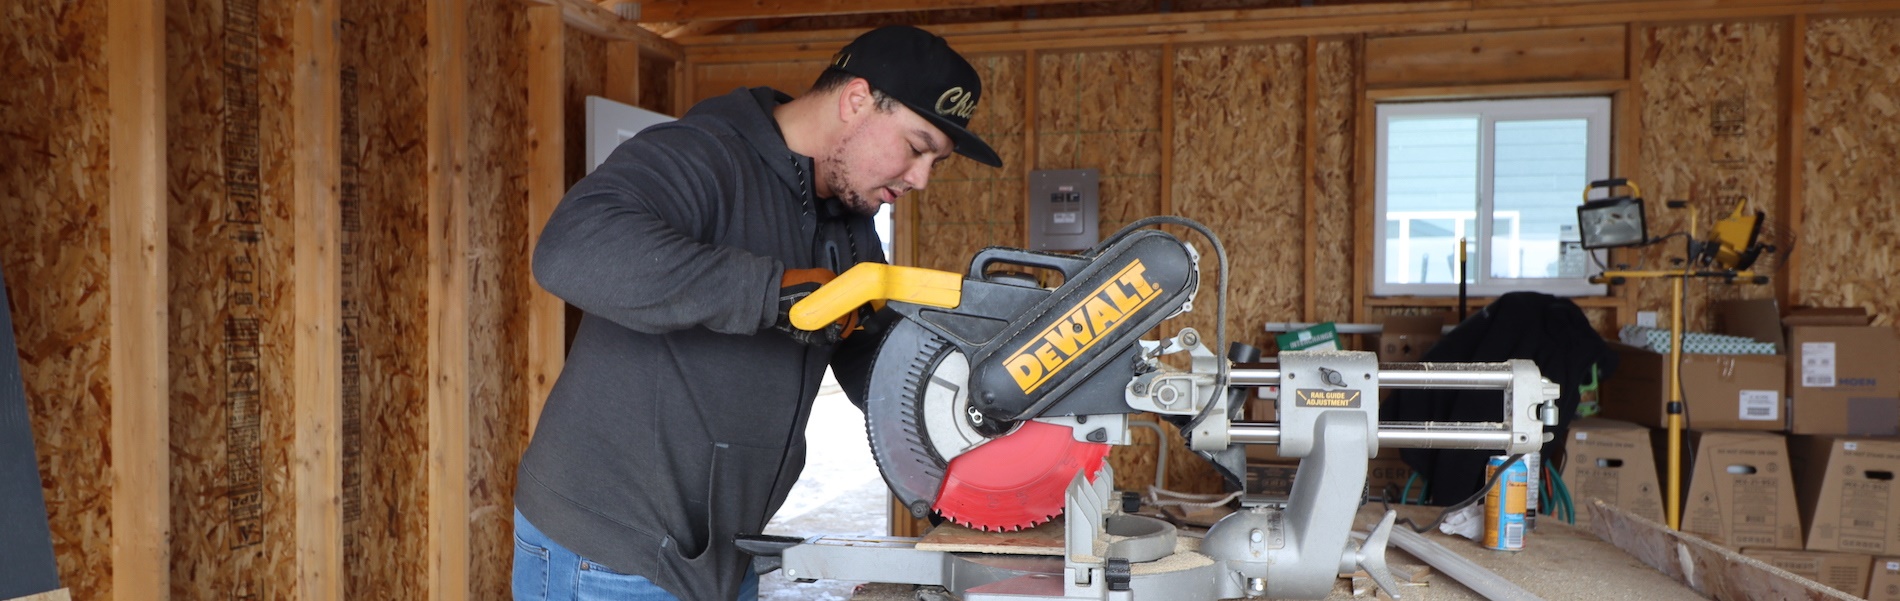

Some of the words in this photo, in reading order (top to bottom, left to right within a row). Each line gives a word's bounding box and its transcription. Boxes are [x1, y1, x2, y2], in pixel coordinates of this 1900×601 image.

[1310, 391, 1325, 399] RAIL
[1306, 399, 1350, 407] ADJUSTMENT
[232, 493, 258, 507] APA
